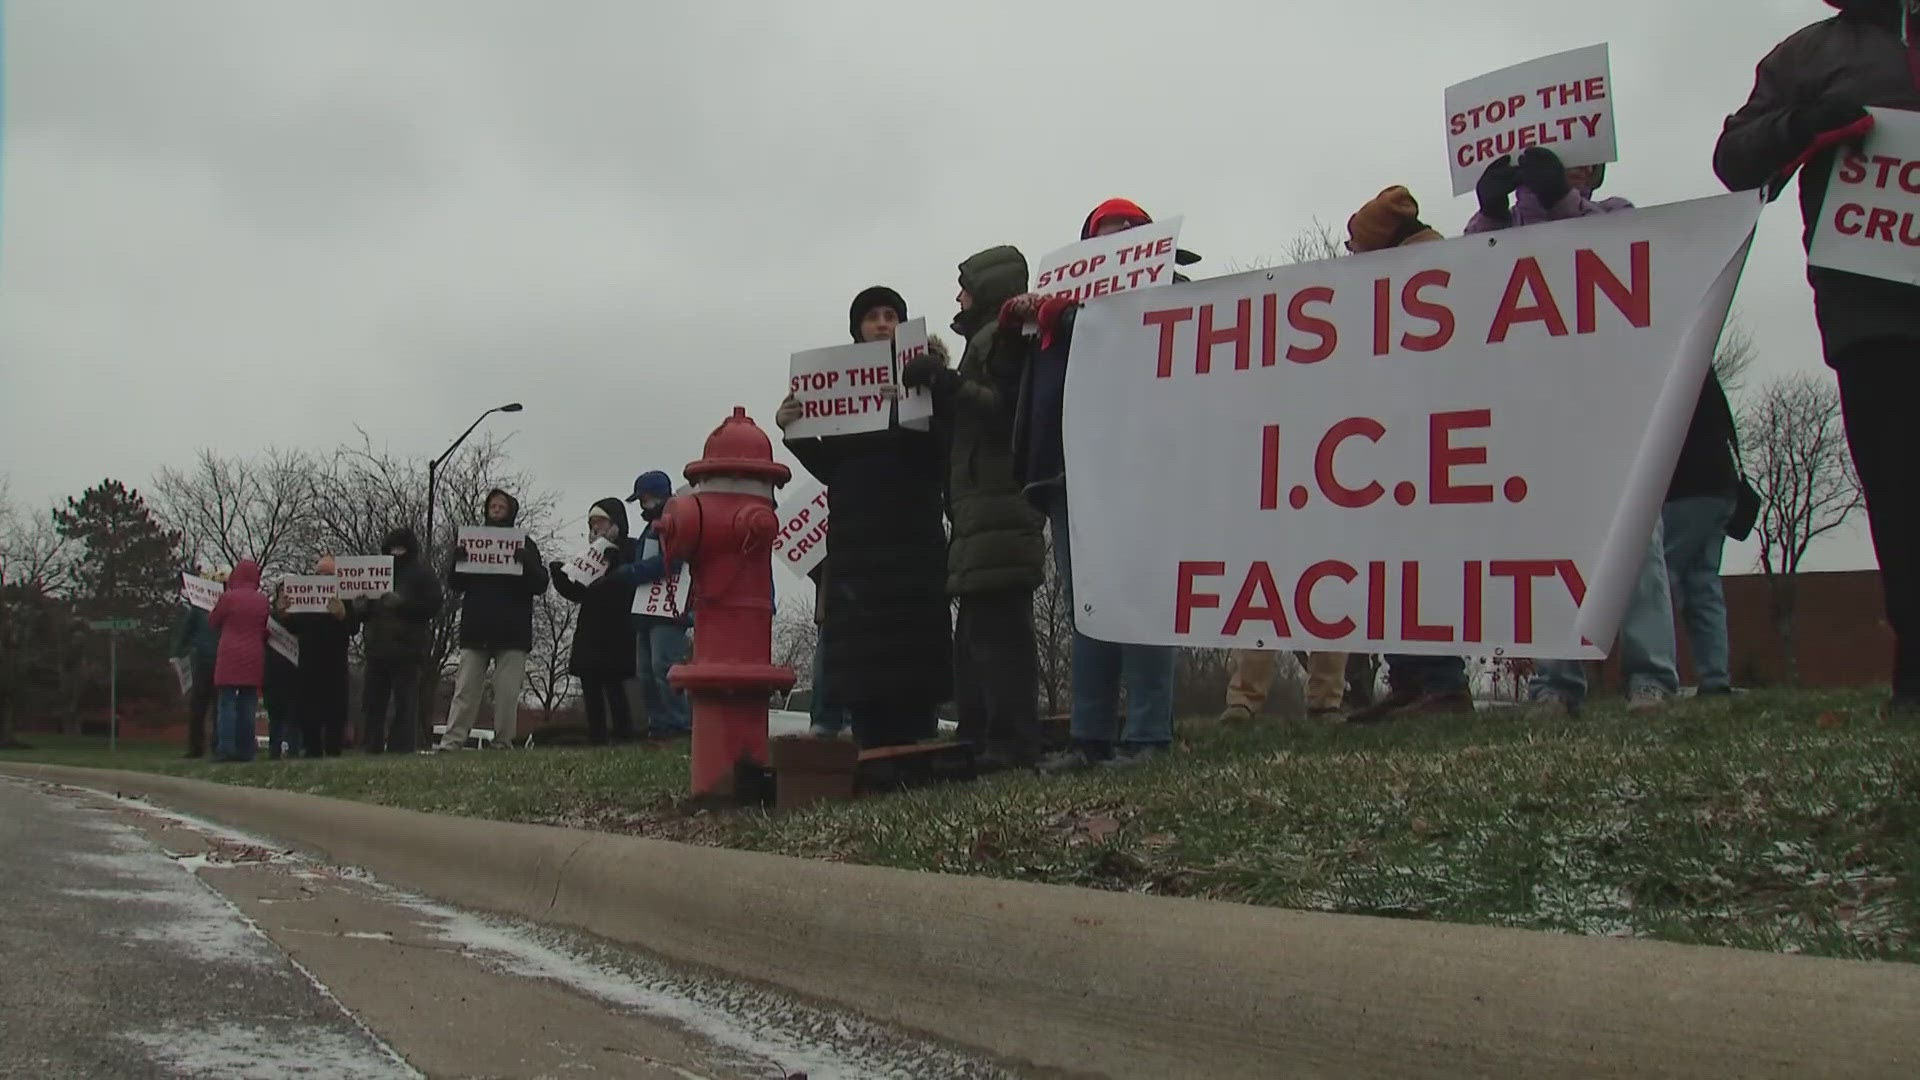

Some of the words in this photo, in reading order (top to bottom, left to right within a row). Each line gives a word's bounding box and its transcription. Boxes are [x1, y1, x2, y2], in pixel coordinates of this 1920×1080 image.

[1450, 95, 1525, 135] STOP
[1536, 76, 1606, 109] THE
[1457, 113, 1602, 168] CRUELTY
[1839, 153, 1920, 194] STO
[1037, 254, 1106, 289] STOP
[1117, 237, 1173, 266] THE
[1041, 264, 1165, 302] RUELTY
[1142, 287, 1337, 379] THIS
[1373, 269, 1456, 356] IS
[1486, 240, 1652, 345] AN
[791, 371, 839, 392] STOP
[846, 366, 890, 387] THE
[1259, 408, 1528, 511] I.C.E.
[286, 584, 313, 594] STOP
[317, 585, 336, 593] THE
[337, 567, 364, 577] STOP
[368, 567, 392, 576] THE
[340, 581, 390, 590] CRUELTY
